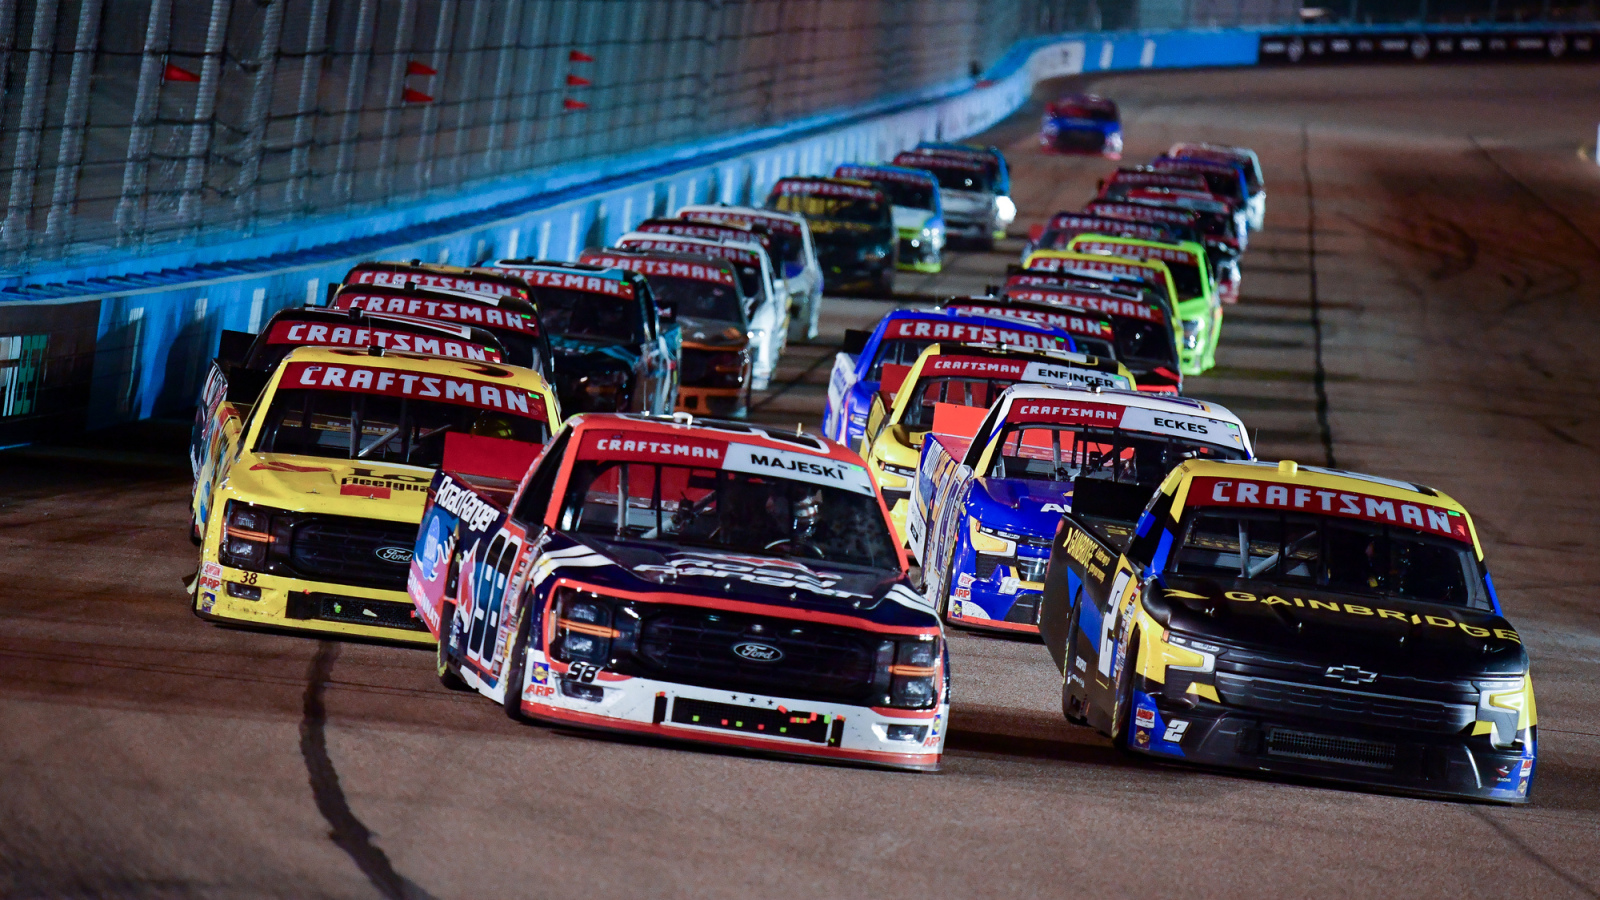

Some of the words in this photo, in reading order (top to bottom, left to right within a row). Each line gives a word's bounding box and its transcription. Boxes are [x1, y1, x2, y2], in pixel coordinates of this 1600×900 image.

[350, 295, 524, 330] CRAFTSMAN
[287, 323, 487, 362] CRAFTSMAN
[900, 322, 1056, 350] CRAFTSMAN
[934, 360, 1020, 374] CRAFTSMAN
[1037, 368, 1114, 389] ENFINGER
[300, 365, 529, 414] CRAFTSMAN
[1020, 405, 1118, 420] CRAFTSMAN
[1153, 417, 1209, 435] ECKES
[596, 438, 720, 459] CRAFTSMAN
[750, 453, 845, 481] MAJESKI
[1211, 480, 1453, 534] CRAFTSMAN
[199, 576, 220, 589] ARP
[240, 571, 258, 585] 38
[954, 588, 970, 598] ARP
[1223, 590, 1522, 646] GAINBRIDGE
[567, 661, 602, 682] 98
[524, 683, 555, 697] ARP
[1162, 719, 1190, 744] 2
